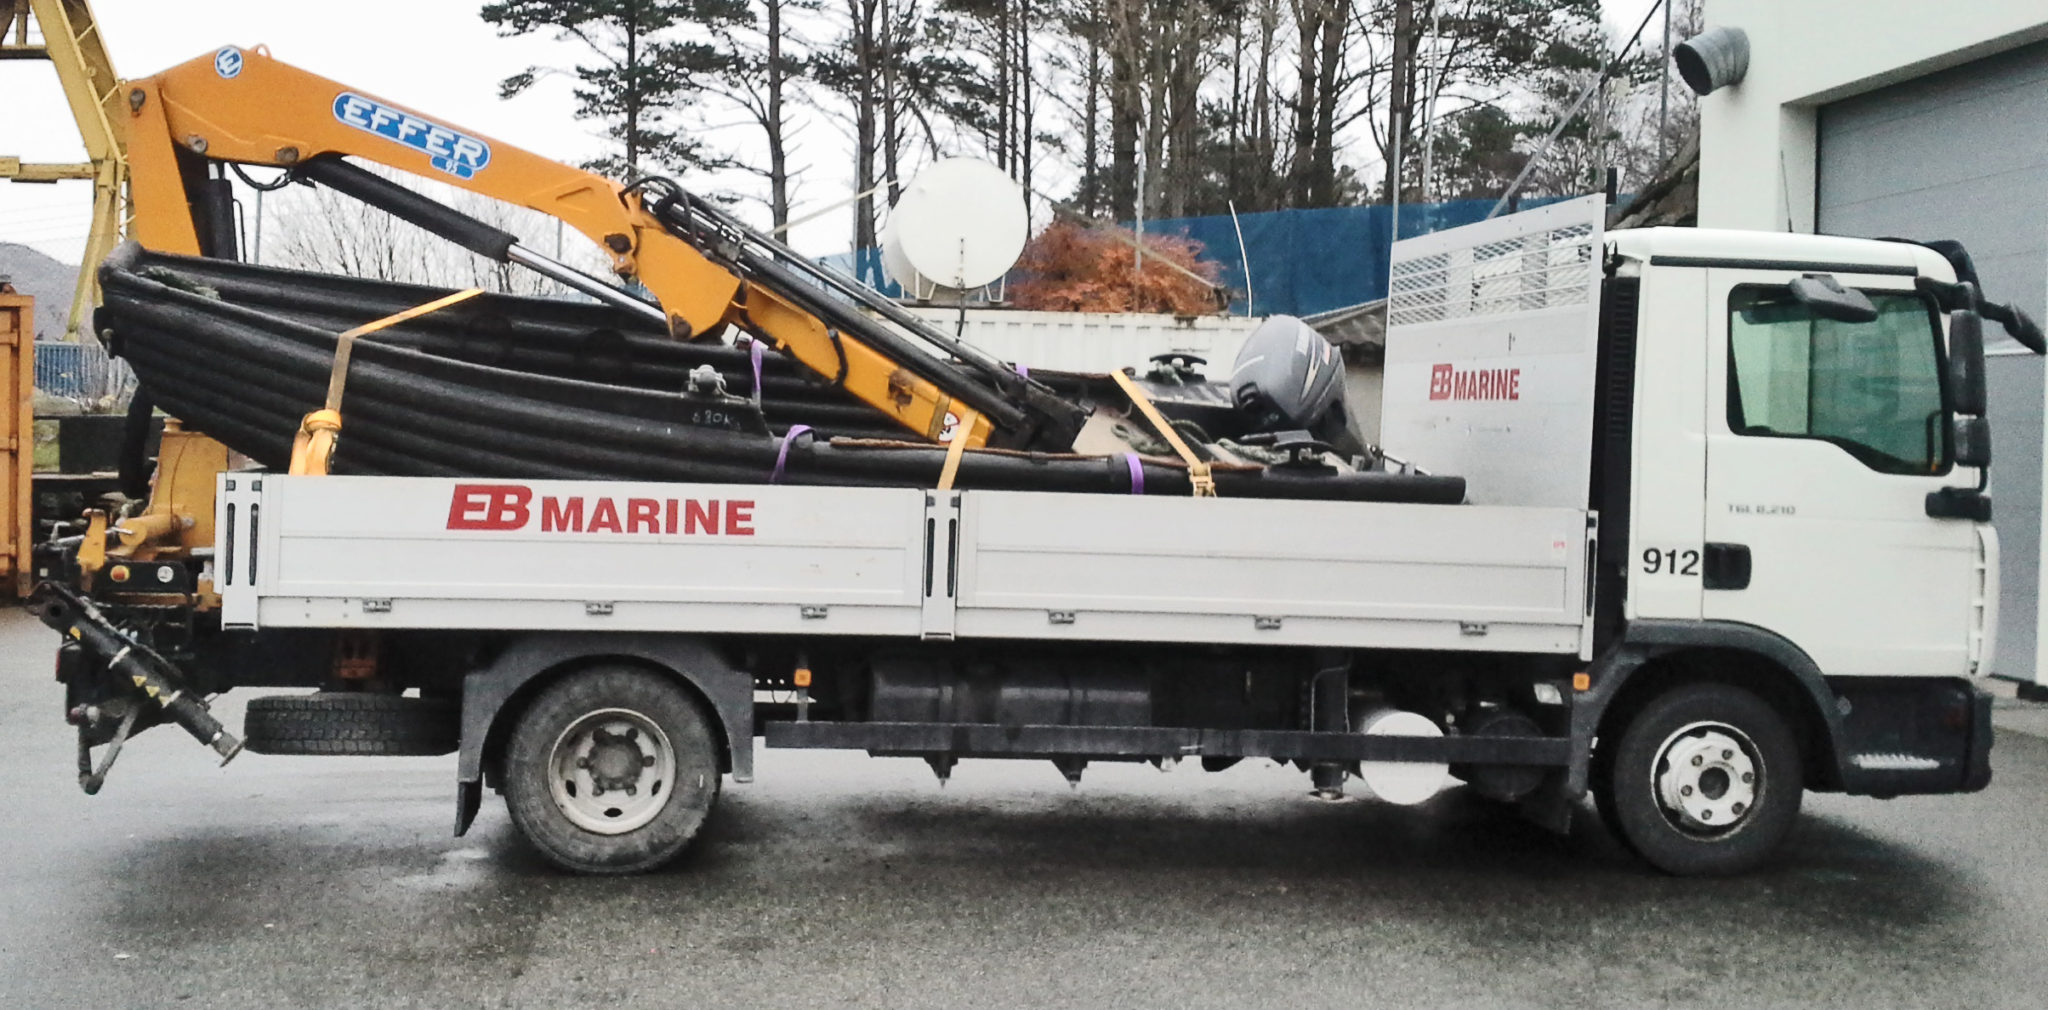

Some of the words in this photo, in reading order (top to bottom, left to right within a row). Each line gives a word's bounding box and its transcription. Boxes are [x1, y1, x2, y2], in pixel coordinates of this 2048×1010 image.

[343, 97, 483, 167] EFFER
[1429, 363, 1453, 401] EB
[1453, 368, 1520, 401] MARINE
[446, 484, 533, 531] EB
[541, 496, 755, 536] MARINE
[1642, 547, 1700, 576] 912
